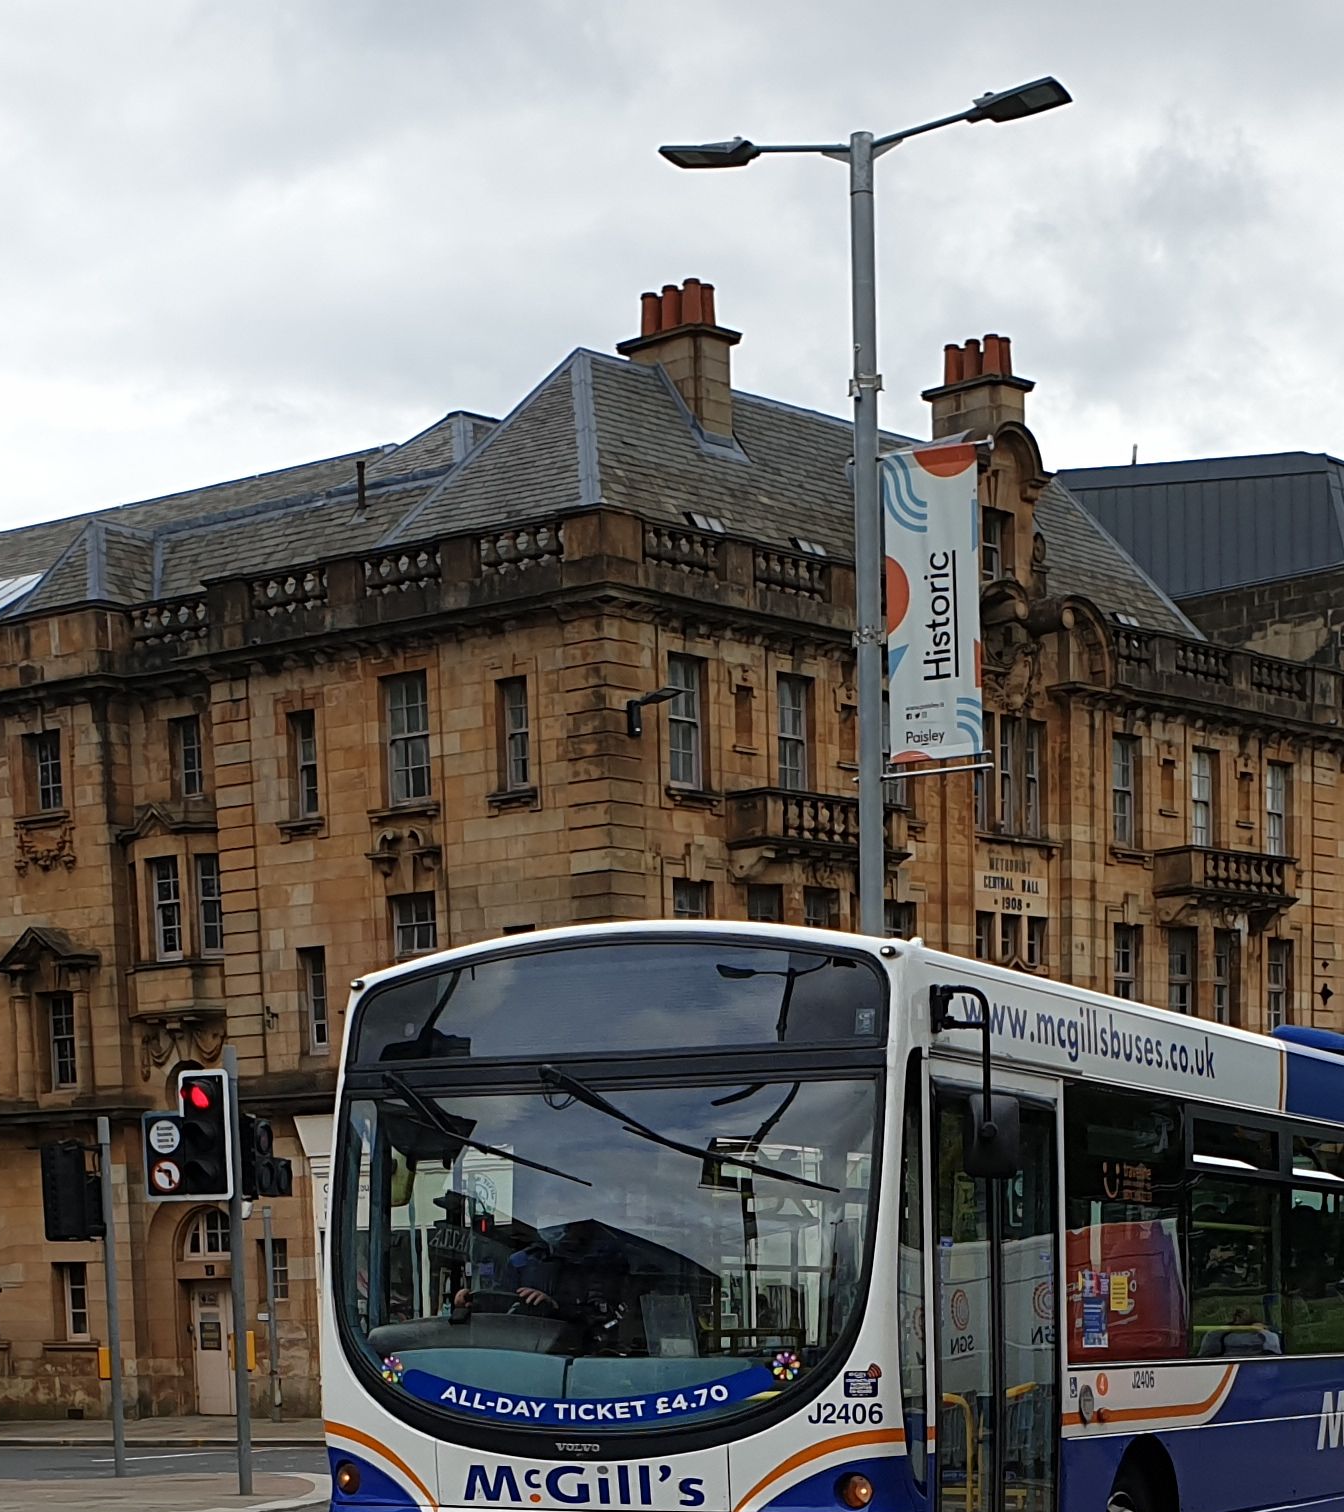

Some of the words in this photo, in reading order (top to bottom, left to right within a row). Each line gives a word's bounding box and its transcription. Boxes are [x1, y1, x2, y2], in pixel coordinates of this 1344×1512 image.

[923, 551, 952, 681] Historic
[906, 729, 945, 745] Paisley
[983, 875, 1014, 892] CENTRAL
[1002, 896, 1023, 911] 1908
[961, 996, 1216, 1079] www.mcgillsbuses.co.uk
[1132, 1370, 1155, 1389] J2406
[440, 1385, 546, 1418] ALL-DAY
[554, 1400, 646, 1421] TICKET
[655, 1384, 729, 1415] £4.70
[807, 1402, 884, 1425] J2406
[555, 1442, 600, 1452] VOLVO
